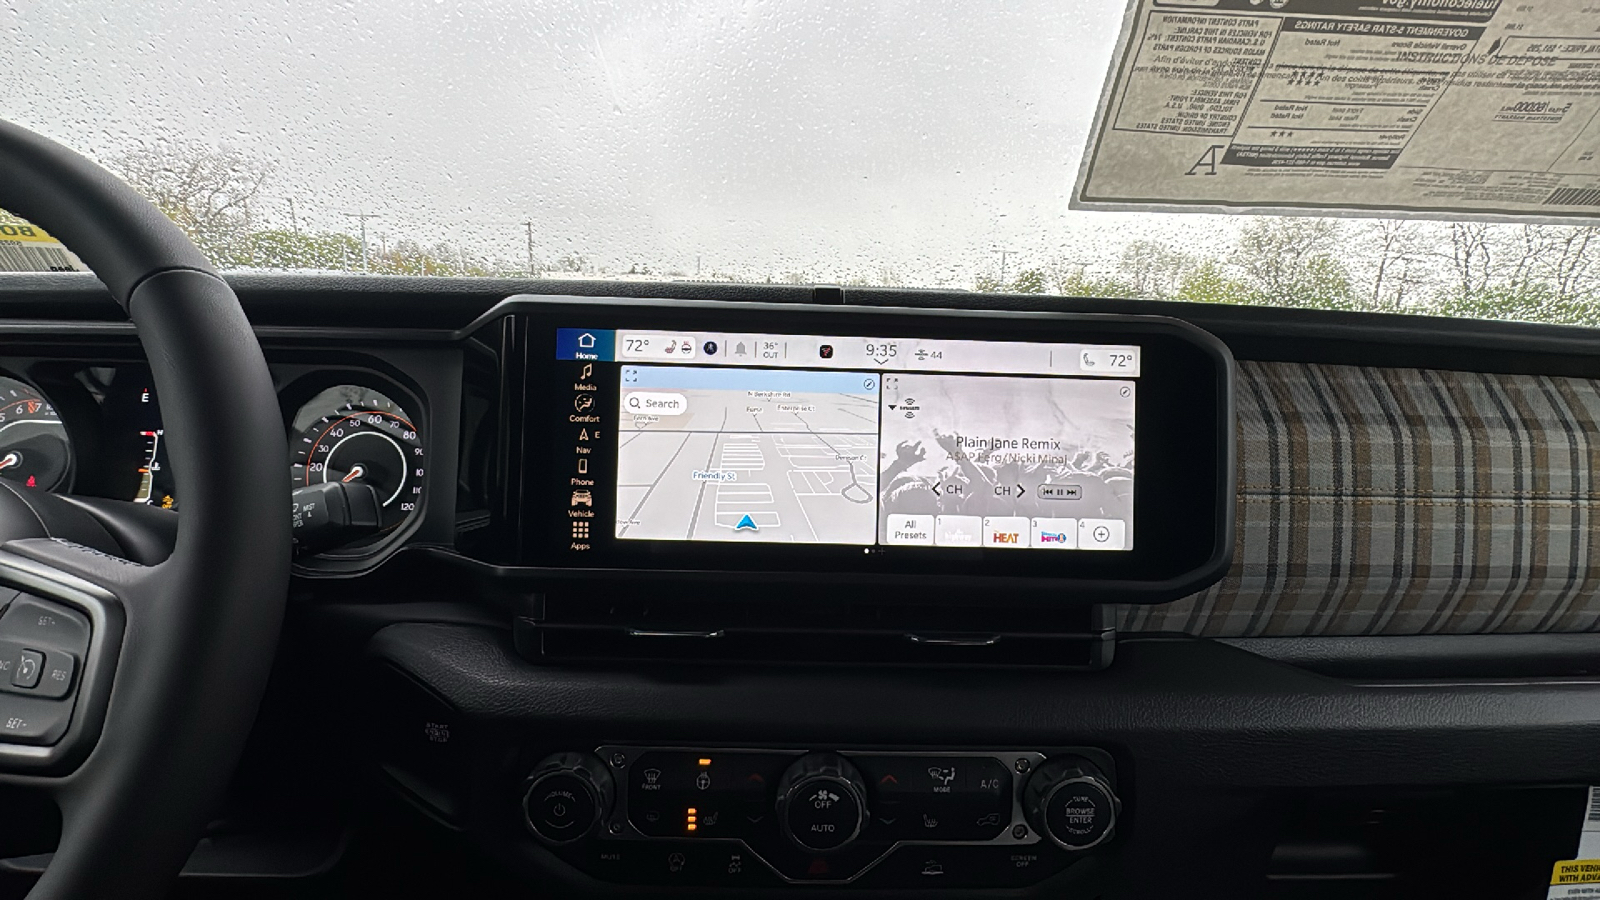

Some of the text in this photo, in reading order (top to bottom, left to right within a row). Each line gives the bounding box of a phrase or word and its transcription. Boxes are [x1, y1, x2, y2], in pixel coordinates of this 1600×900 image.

[763, 351, 779, 359] OUT
[866, 344, 898, 357] 9:35
[930, 351, 943, 359] 44
[575, 352, 598, 361] Home
[574, 383, 598, 391] Media
[142, 393, 150, 403] E
[34, 403, 42, 412] 7
[645, 398, 680, 410] Search
[16, 405, 23, 414] 6
[367, 415, 382, 424] 60
[569, 414, 600, 423] Comfort
[389, 421, 400, 429] 70
[329, 428, 344, 437] 40
[402, 431, 416, 440] 80
[956, 436, 1061, 450] Plain Jane Remix
[318, 445, 329, 453] 30
[576, 446, 592, 454] Nav
[309, 463, 324, 472] 20
[692, 470, 726, 481] Friendly
[571, 477, 595, 486] Phone
[946, 484, 963, 494] CH
[994, 485, 1011, 496] CH
[401, 503, 415, 511] 120
[568, 509, 595, 518] Vehicle
[905, 520, 917, 528] All
[895, 530, 927, 540] Presets
[993, 532, 1020, 544] HEAT
[570, 542, 591, 551] Apps
[980, 778, 999, 789] A/C
[814, 800, 832, 809] OFF
[1065, 807, 1095, 816] BROWSE
[1069, 816, 1093, 824] ENTER
[810, 824, 835, 832] AUTO
[1561, 864, 1600, 873] THIS VEHI
[1559, 874, 1579, 882] WITH
